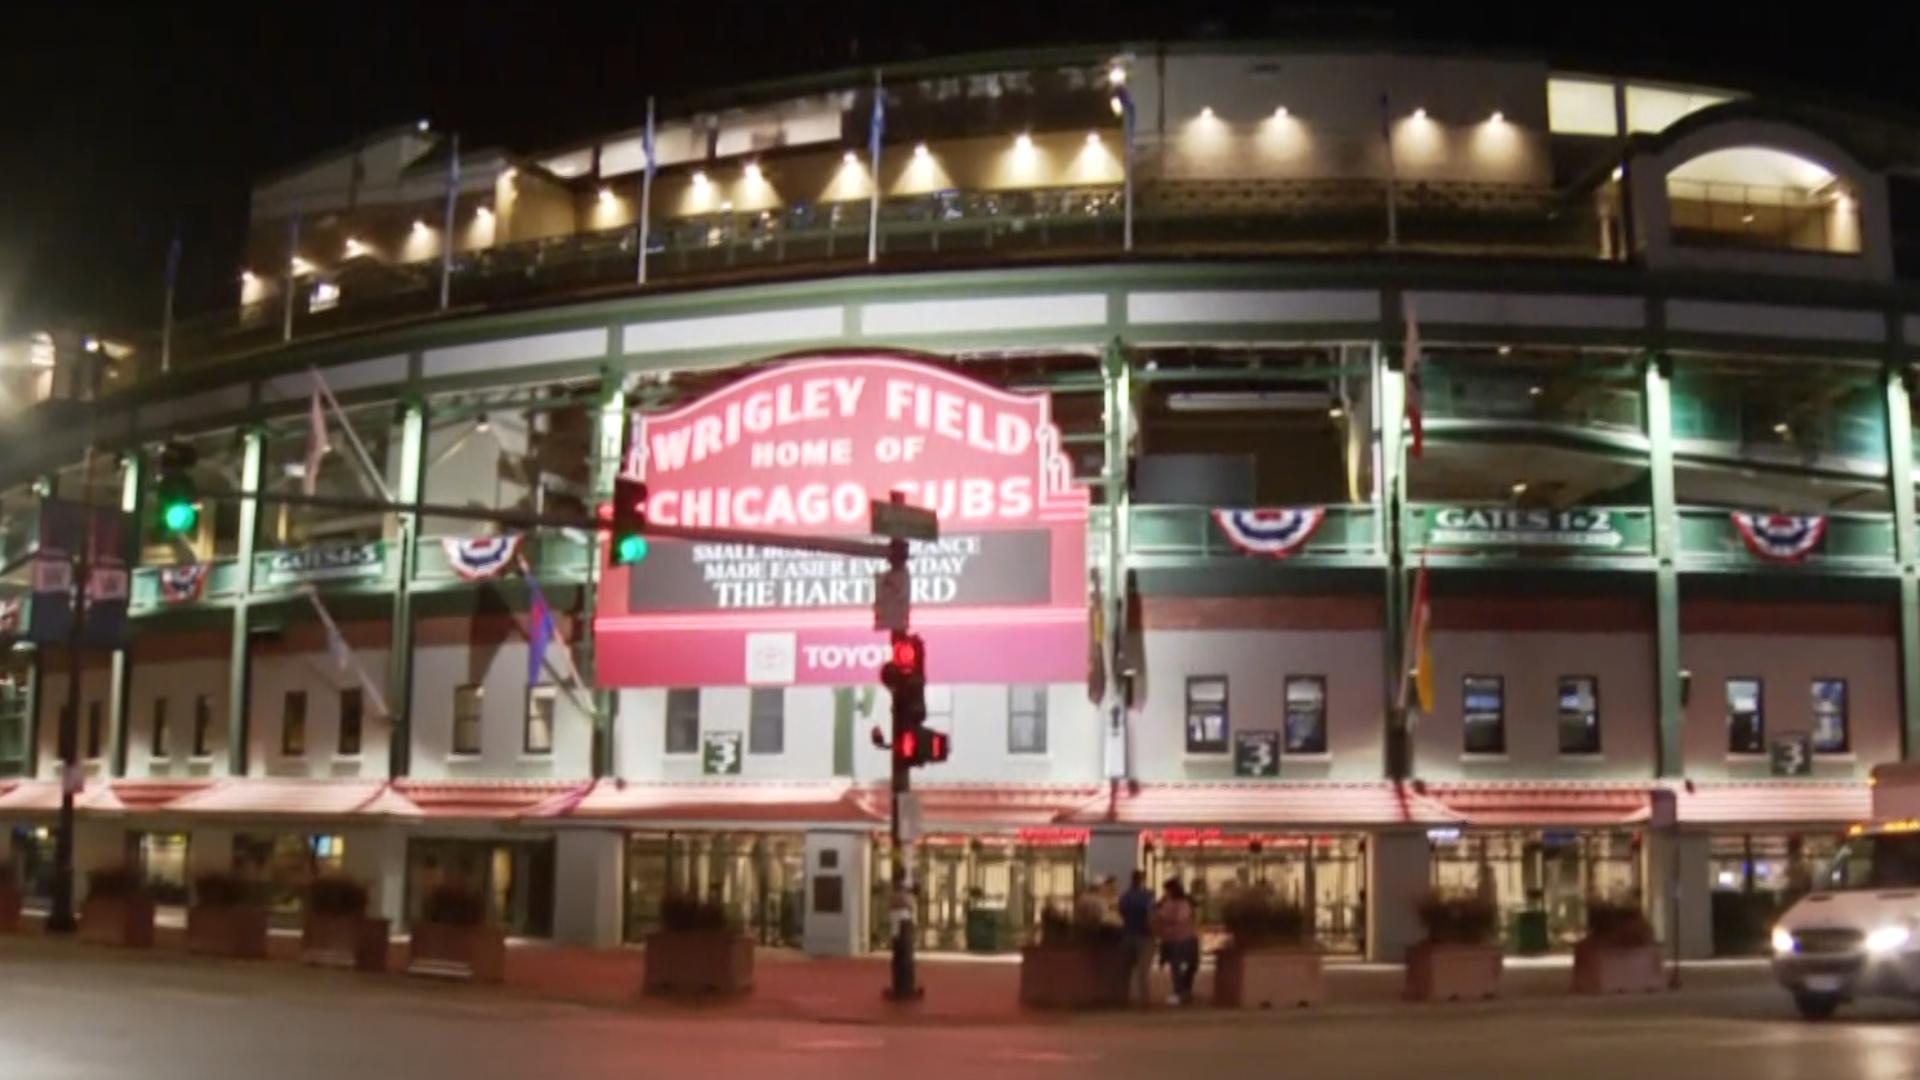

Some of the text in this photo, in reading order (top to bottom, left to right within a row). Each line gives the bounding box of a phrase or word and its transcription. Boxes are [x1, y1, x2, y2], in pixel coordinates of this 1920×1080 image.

[651, 377, 1032, 473] WRIGLEY FIELD
[751, 435, 926, 468] HOME OF
[648, 477, 1032, 527] CHICAGO UBS
[704, 560, 763, 580] MADE
[769, 559, 844, 578] EASIER
[713, 576, 957, 608] THE HARTRD
